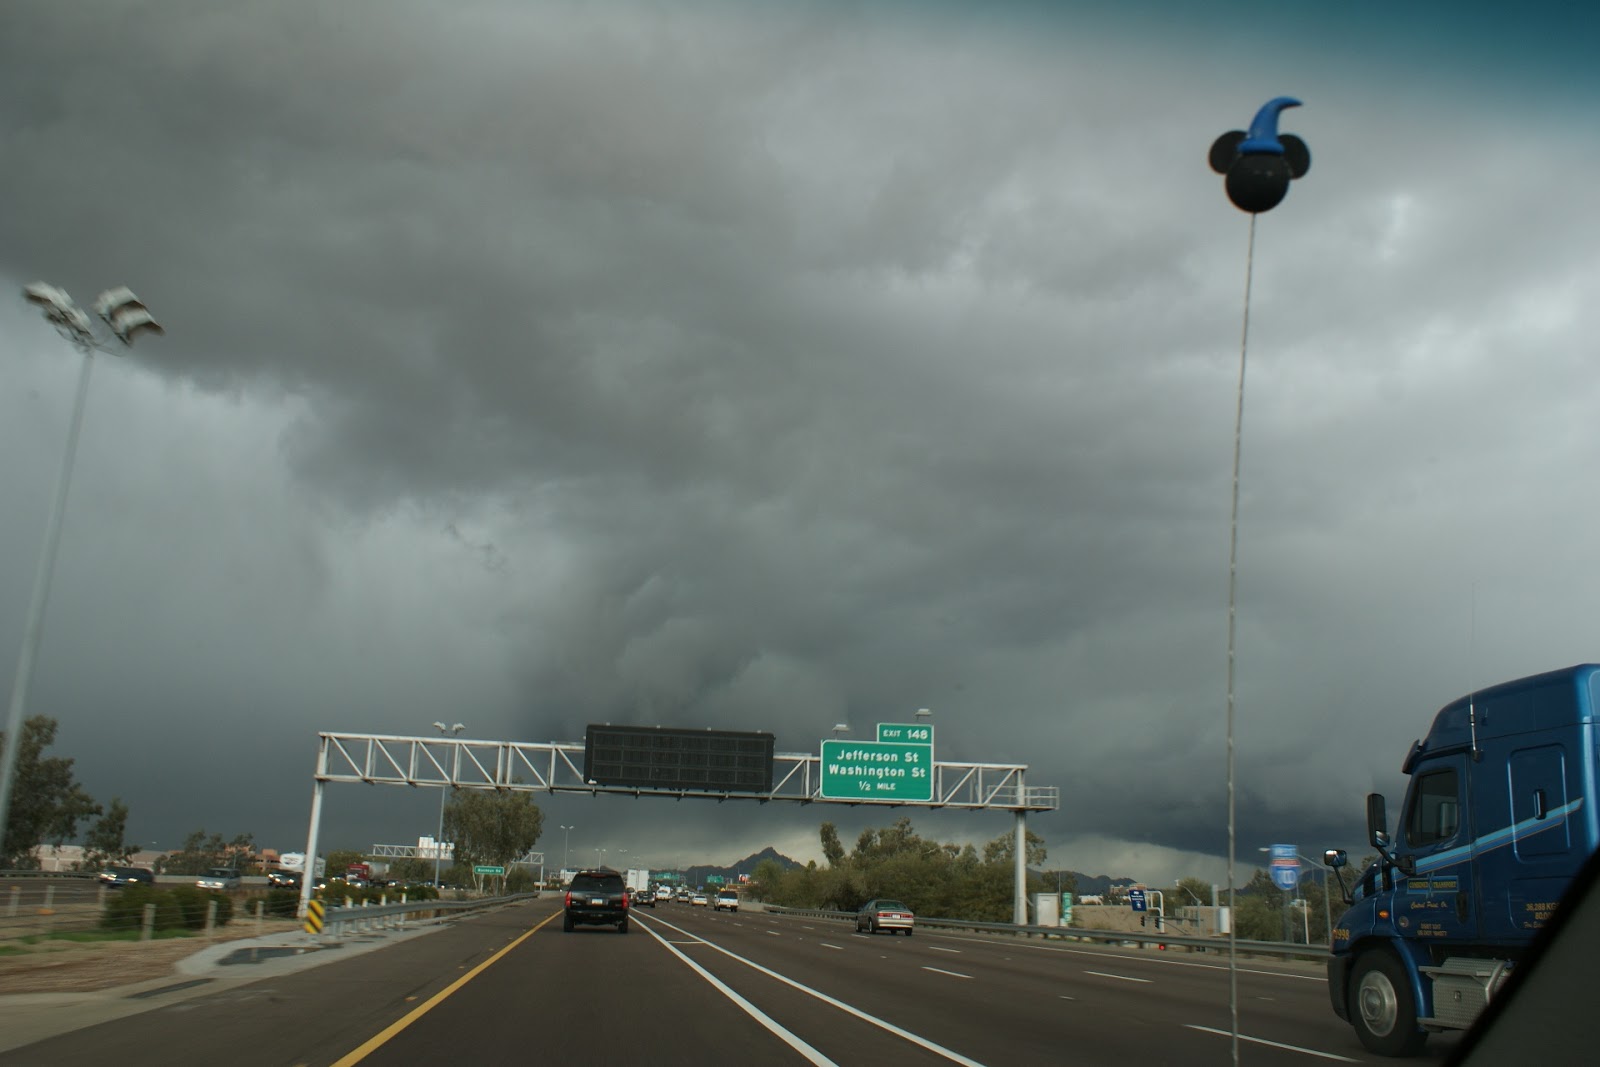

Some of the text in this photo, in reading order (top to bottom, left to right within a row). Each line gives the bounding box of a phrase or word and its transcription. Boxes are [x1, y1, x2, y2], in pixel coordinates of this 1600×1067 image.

[882, 729, 929, 740] EXIT 148
[836, 749, 919, 763] Jefferson St
[828, 764, 926, 779] Washington St
[876, 782, 897, 791] MILE
